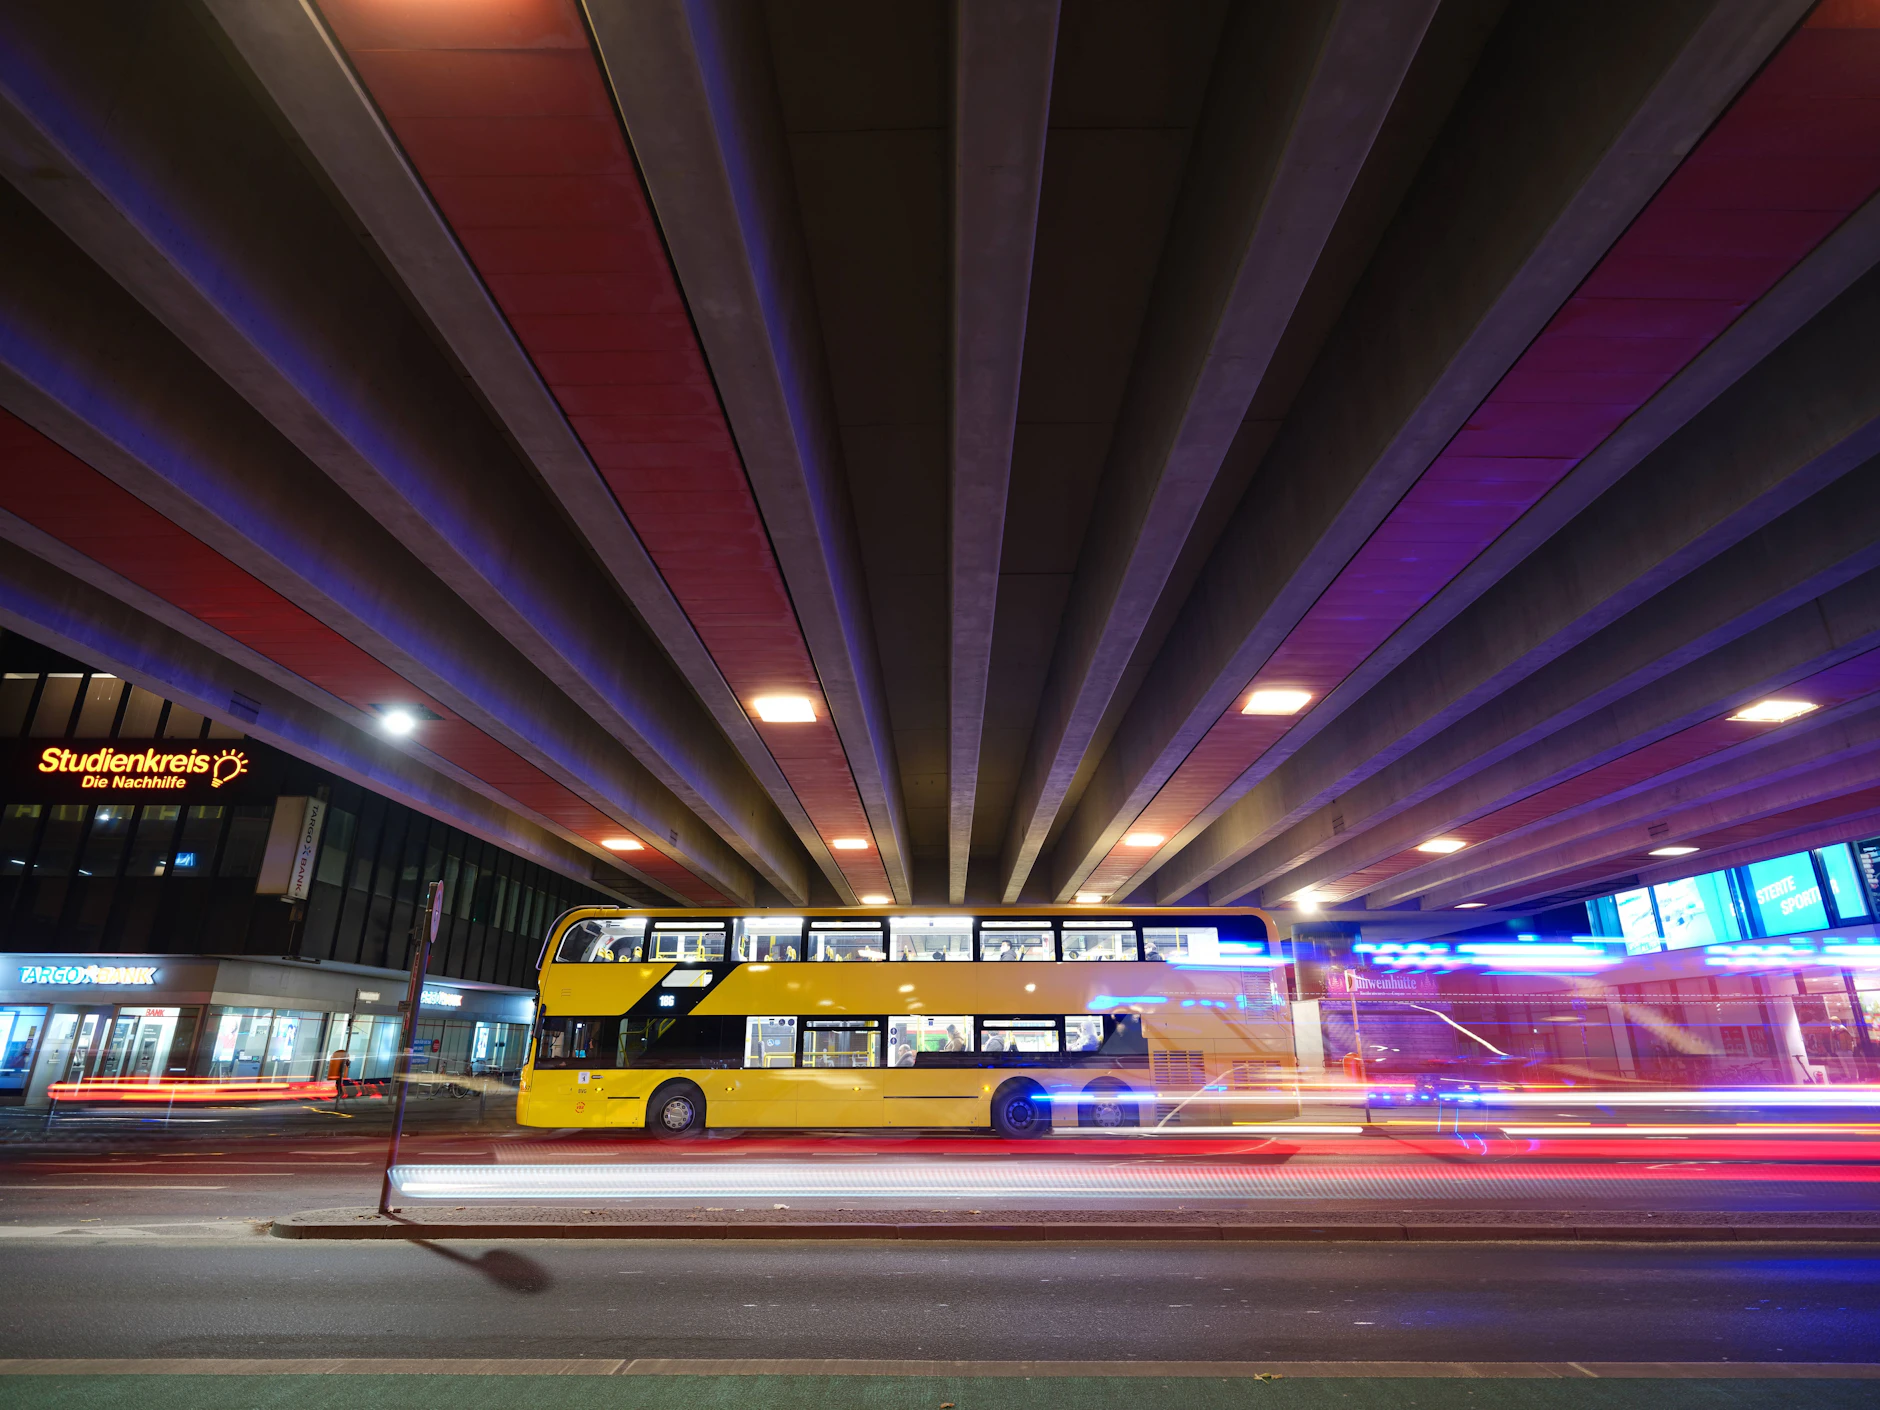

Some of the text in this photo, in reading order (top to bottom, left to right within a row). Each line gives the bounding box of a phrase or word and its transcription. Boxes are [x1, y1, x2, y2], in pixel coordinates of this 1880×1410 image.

[38, 747, 211, 773] Studienkreis
[81, 775, 187, 788] Die Nachhilfe
[295, 805, 320, 892] TARGO BANK
[1755, 875, 1797, 905] STERTE
[659, 995, 675, 1007] 186
[145, 1008, 165, 1017] BANK
